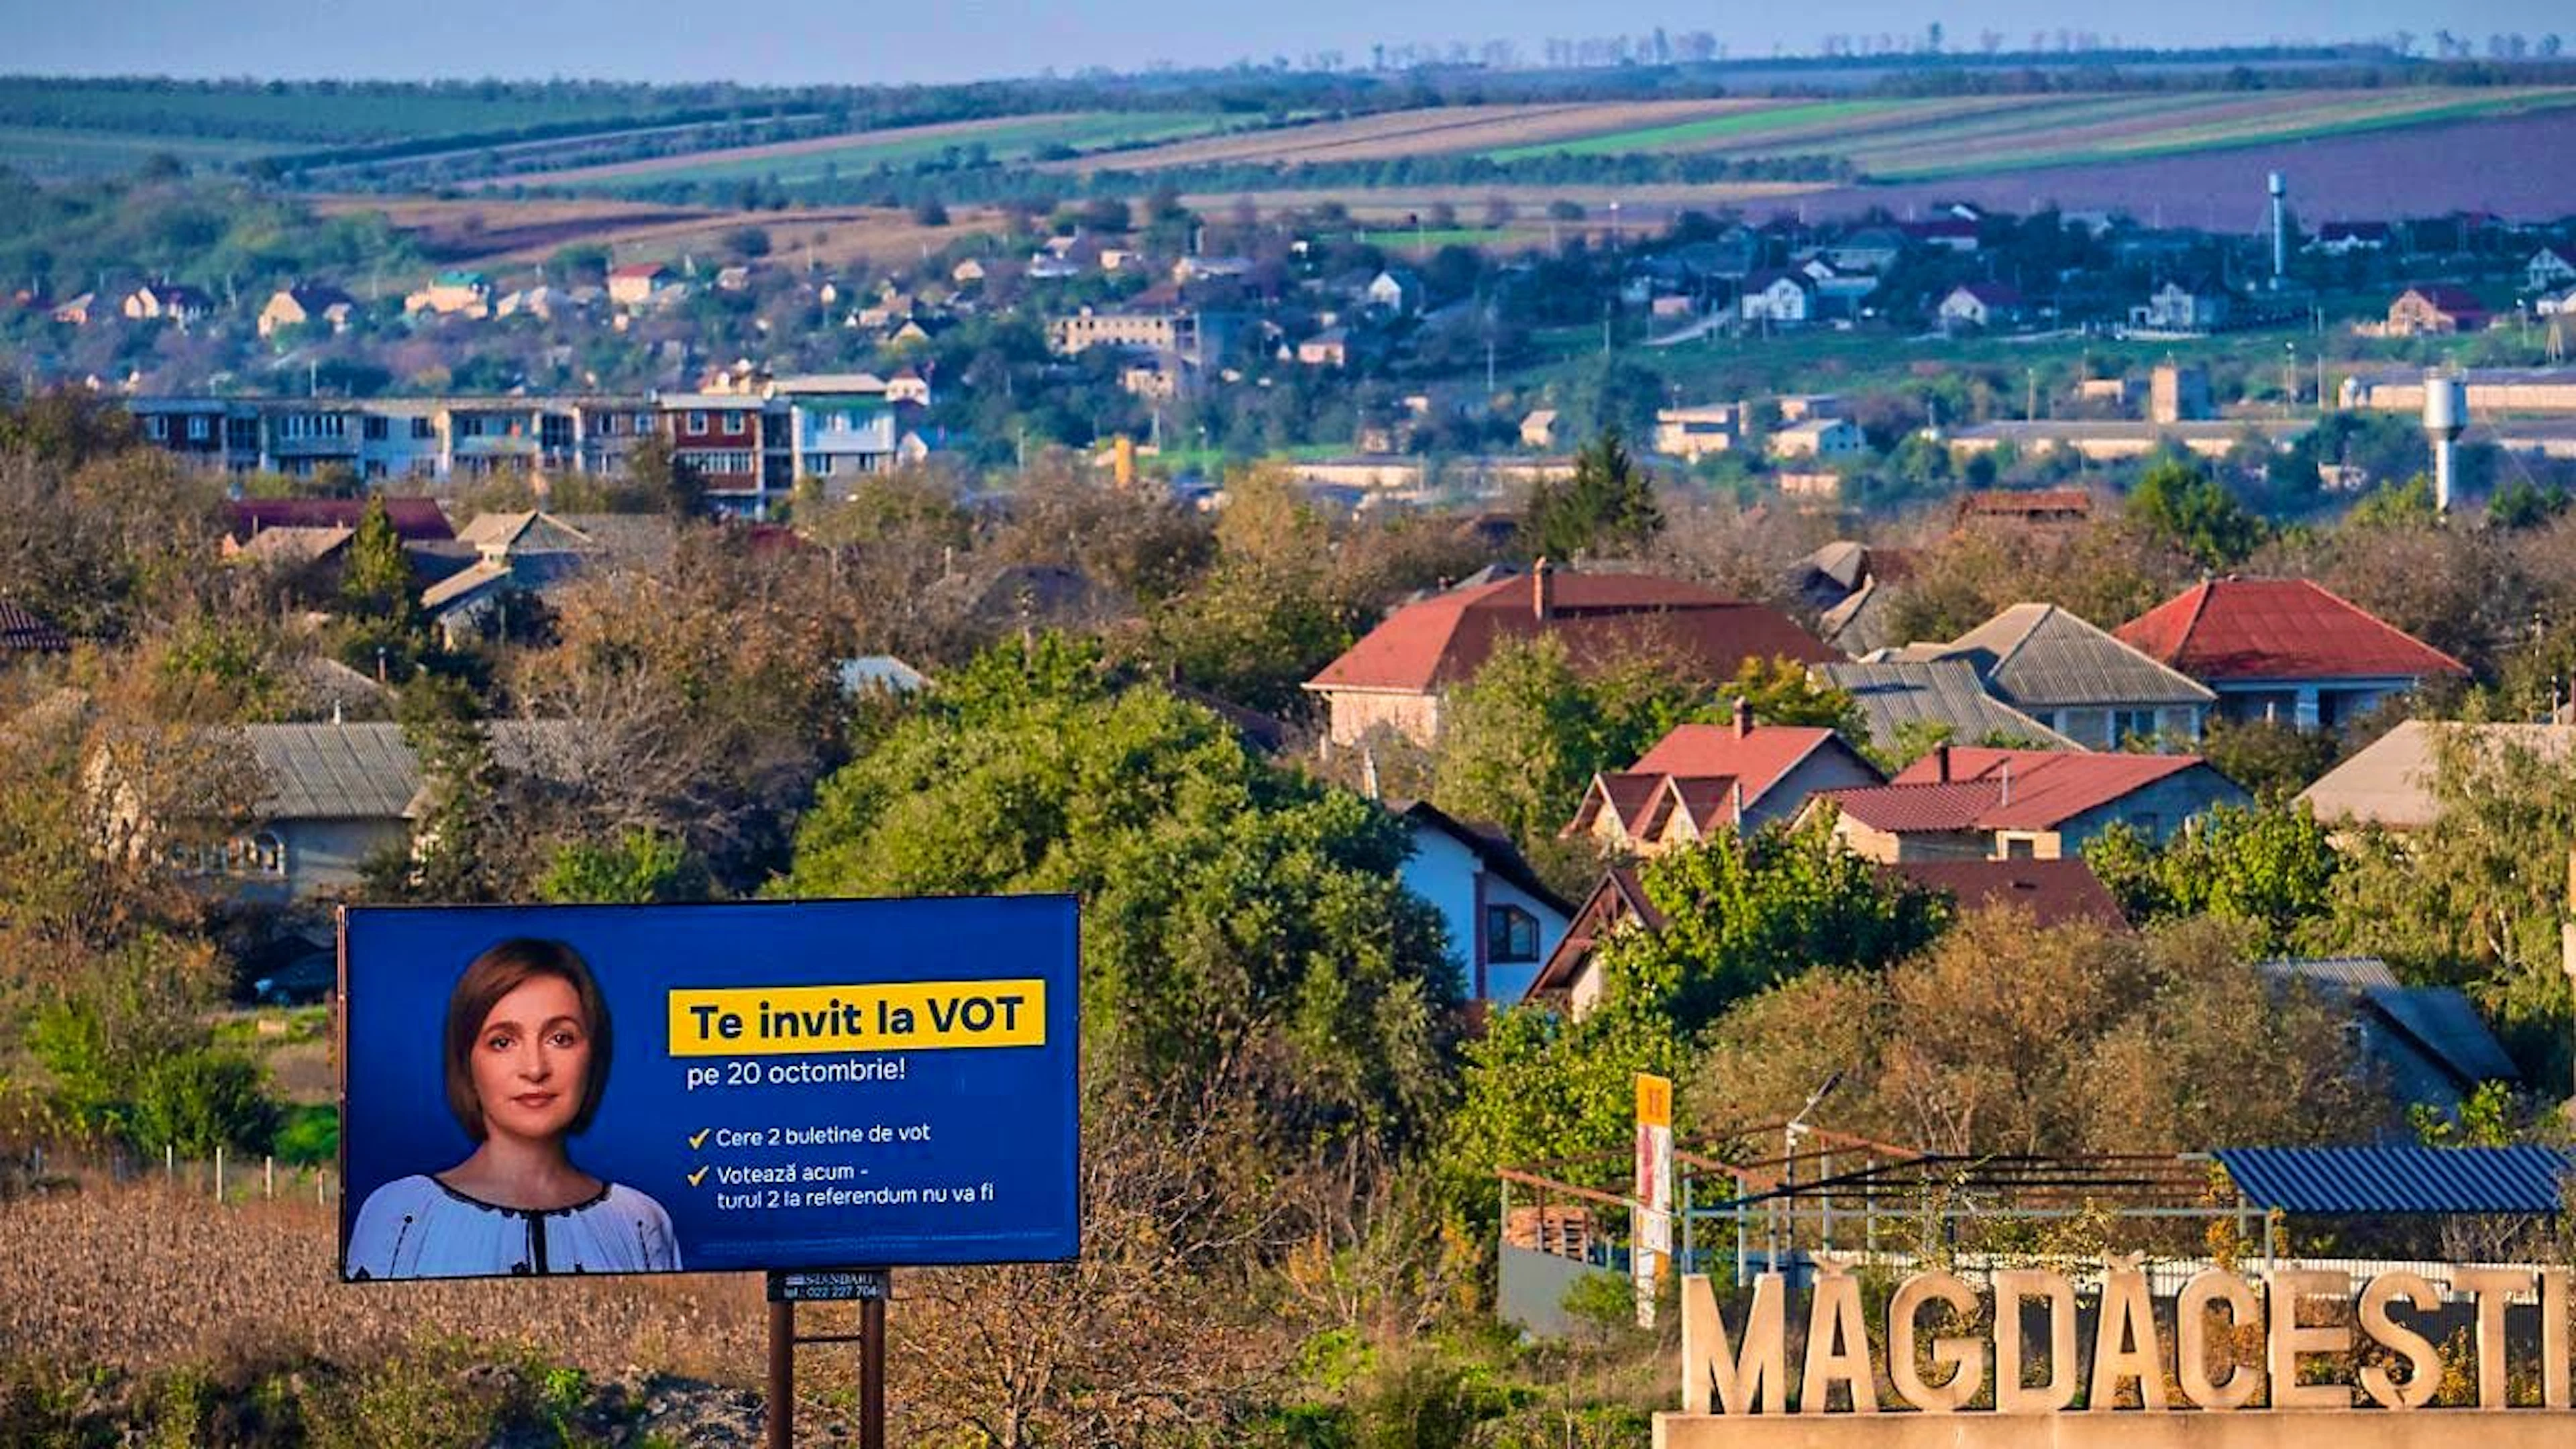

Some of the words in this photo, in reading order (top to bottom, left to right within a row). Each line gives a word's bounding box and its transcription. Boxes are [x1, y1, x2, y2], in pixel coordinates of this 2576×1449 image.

[690, 1005, 743, 1040] Te
[759, 998, 862, 1038] invit
[877, 1000, 915, 1035] la
[927, 996, 1024, 1032] VOT
[687, 1068, 720, 1091] pe
[727, 1062, 762, 1085] 20
[767, 1058, 906, 1084] octombrie!
[715, 1128, 763, 1147] Cere
[767, 1128, 781, 1146] 2
[786, 1126, 863, 1146] buletine
[868, 1124, 893, 1142] de
[898, 1123, 932, 1141] vot
[716, 1163, 797, 1183] Votează
[802, 1165, 855, 1181] acum
[717, 1191, 763, 1210] turul
[767, 1189, 780, 1208] 2
[784, 1188, 801, 1207] la
[806, 1186, 918, 1207] referendum
[922, 1187, 947, 1203] nu
[951, 1186, 976, 1202] va
[980, 1182, 995, 1201] fi
